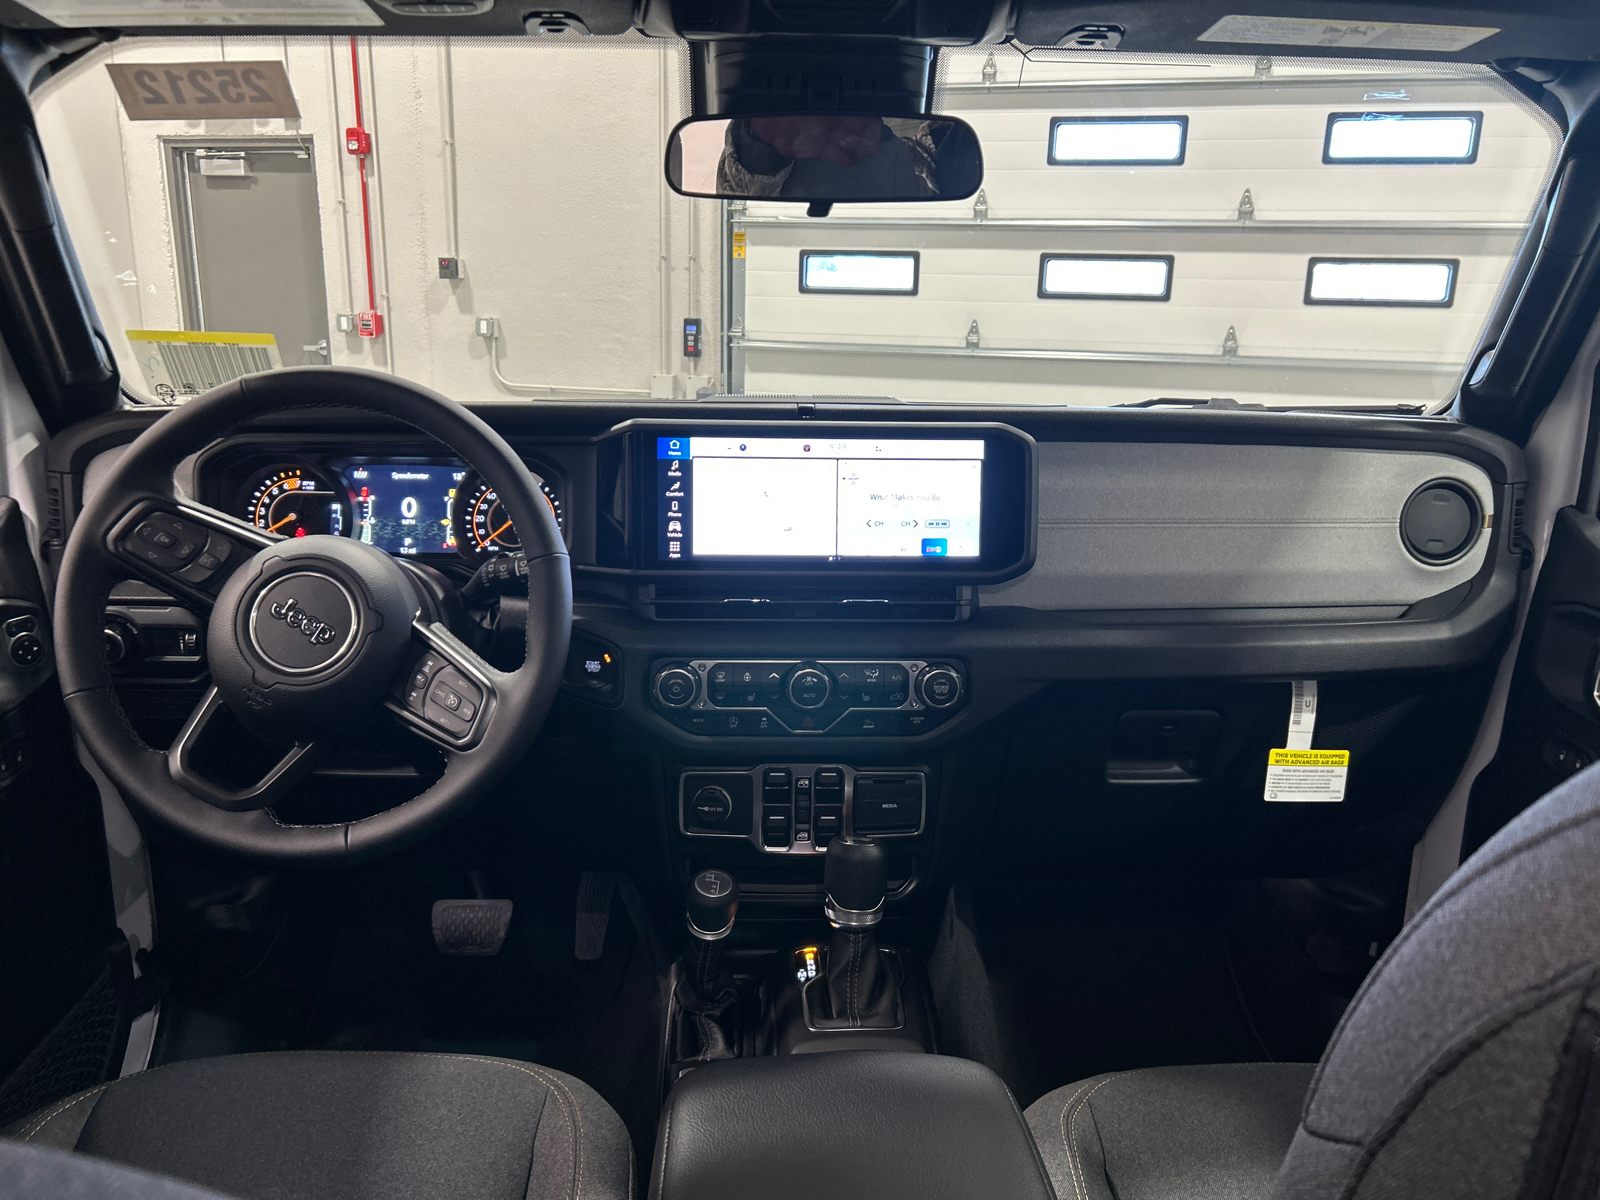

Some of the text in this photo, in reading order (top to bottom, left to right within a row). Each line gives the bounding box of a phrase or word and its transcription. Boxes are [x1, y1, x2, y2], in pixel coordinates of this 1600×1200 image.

[401, 497, 417, 518] 0
[160, 535, 170, 544] OK
[404, 538, 412, 546] P
[270, 598, 336, 646] Jeep
